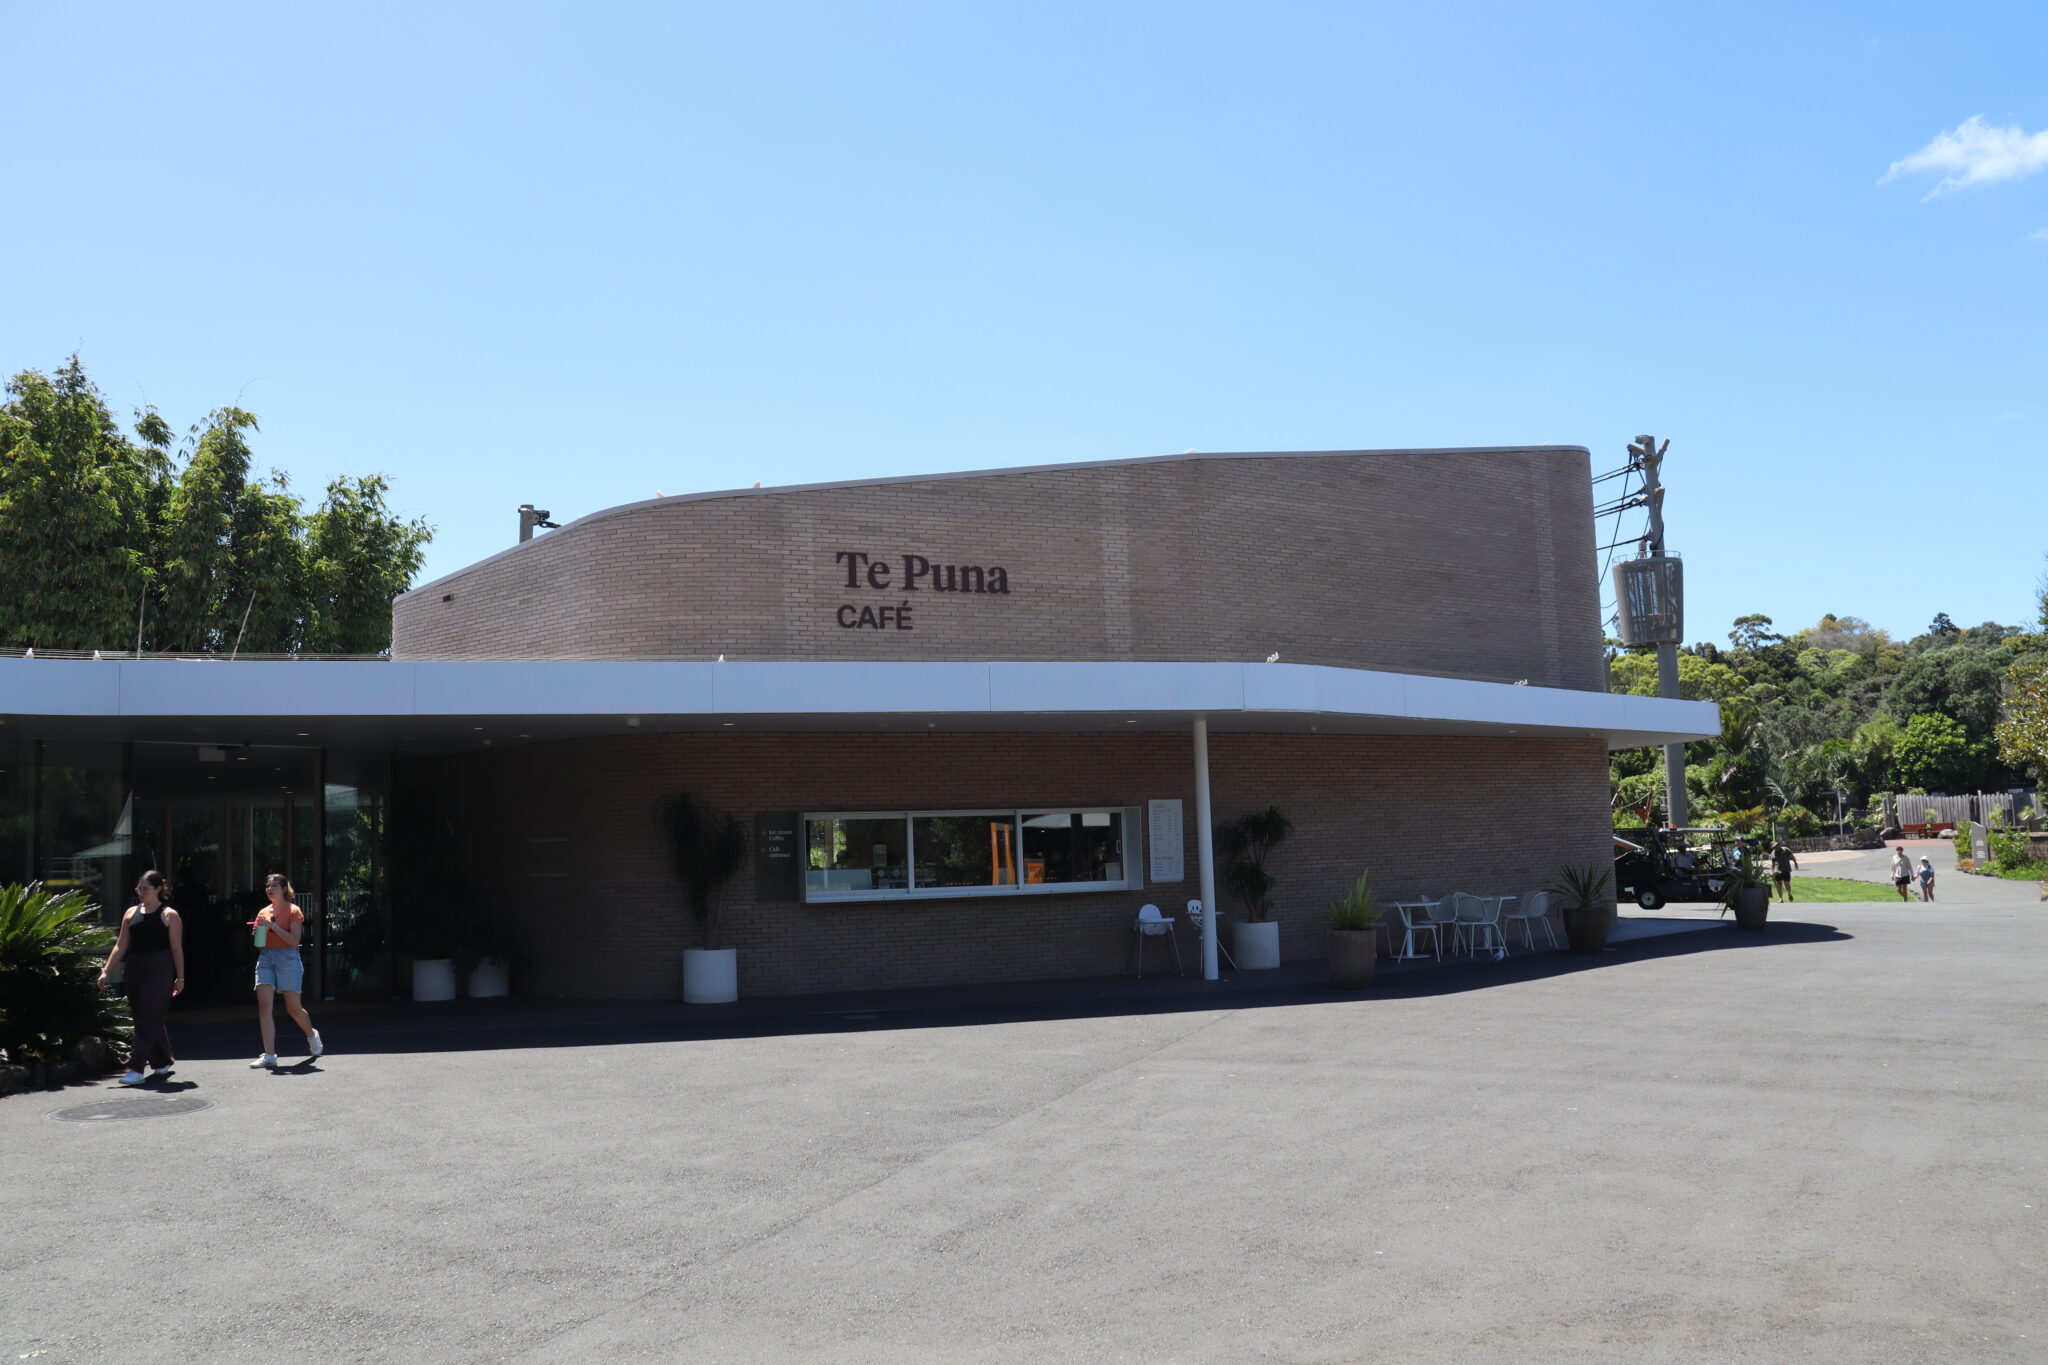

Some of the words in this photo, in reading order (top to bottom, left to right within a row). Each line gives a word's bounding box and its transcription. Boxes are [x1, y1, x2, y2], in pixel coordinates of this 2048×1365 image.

[836, 551, 890, 590] Te
[901, 554, 1011, 594] Puna
[836, 600, 913, 630] CAFÉ
